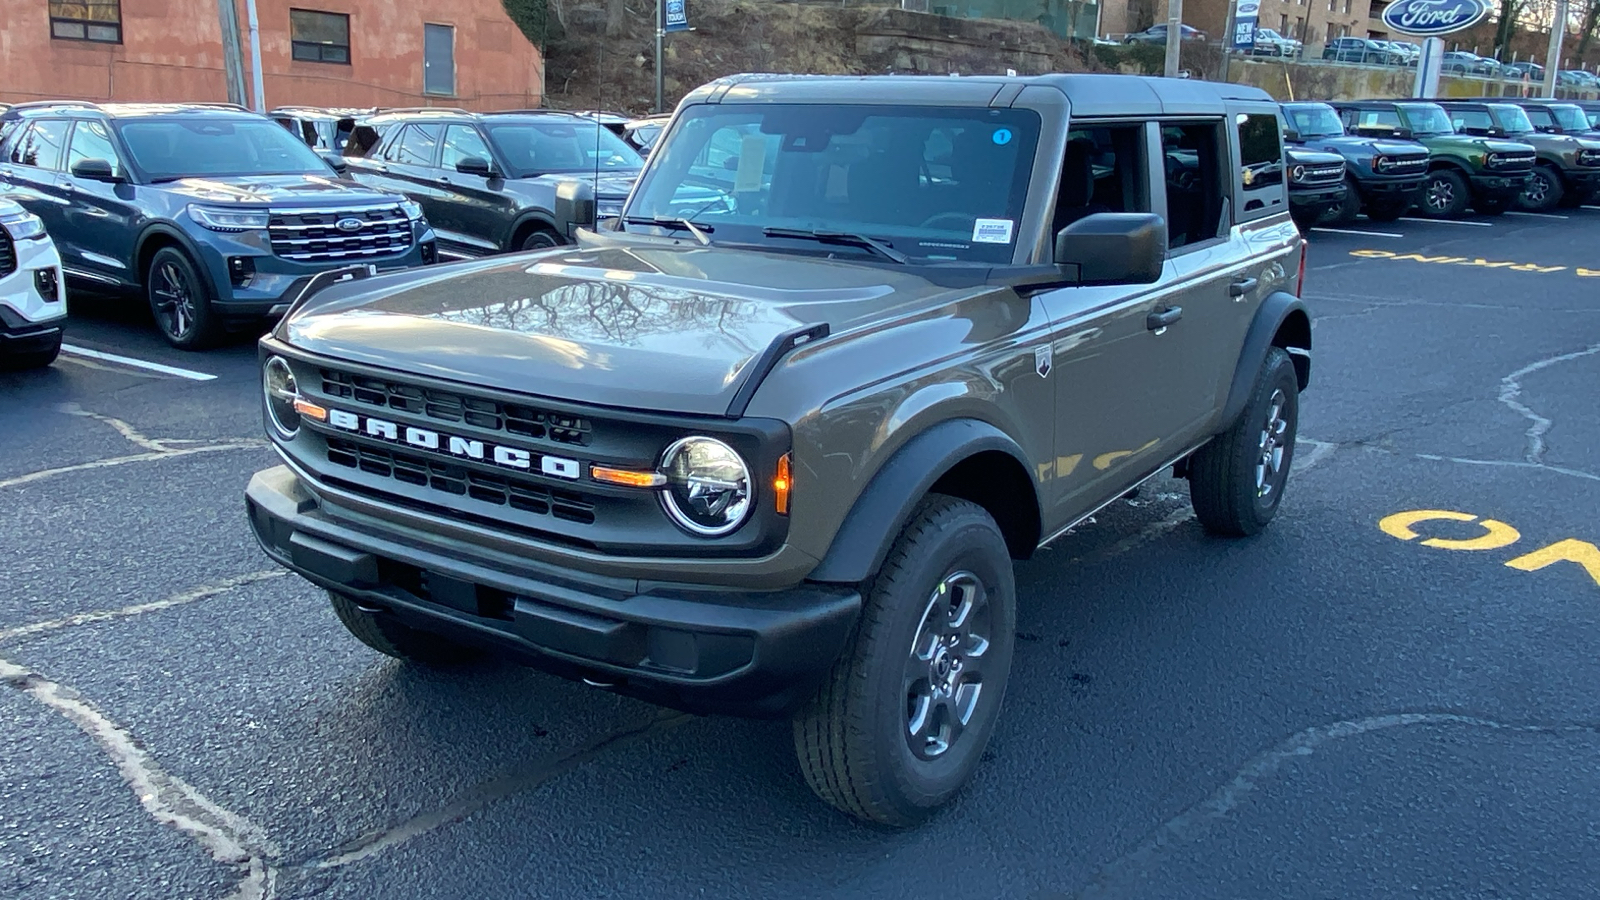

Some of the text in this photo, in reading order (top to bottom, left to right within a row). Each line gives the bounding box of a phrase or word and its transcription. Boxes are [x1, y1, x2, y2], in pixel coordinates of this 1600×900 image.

[1401, 0, 1462, 26] Ford
[1237, 22, 1254, 34] NEW
[1236, 33, 1252, 44] CARS
[330, 409, 580, 479] BRONCO
